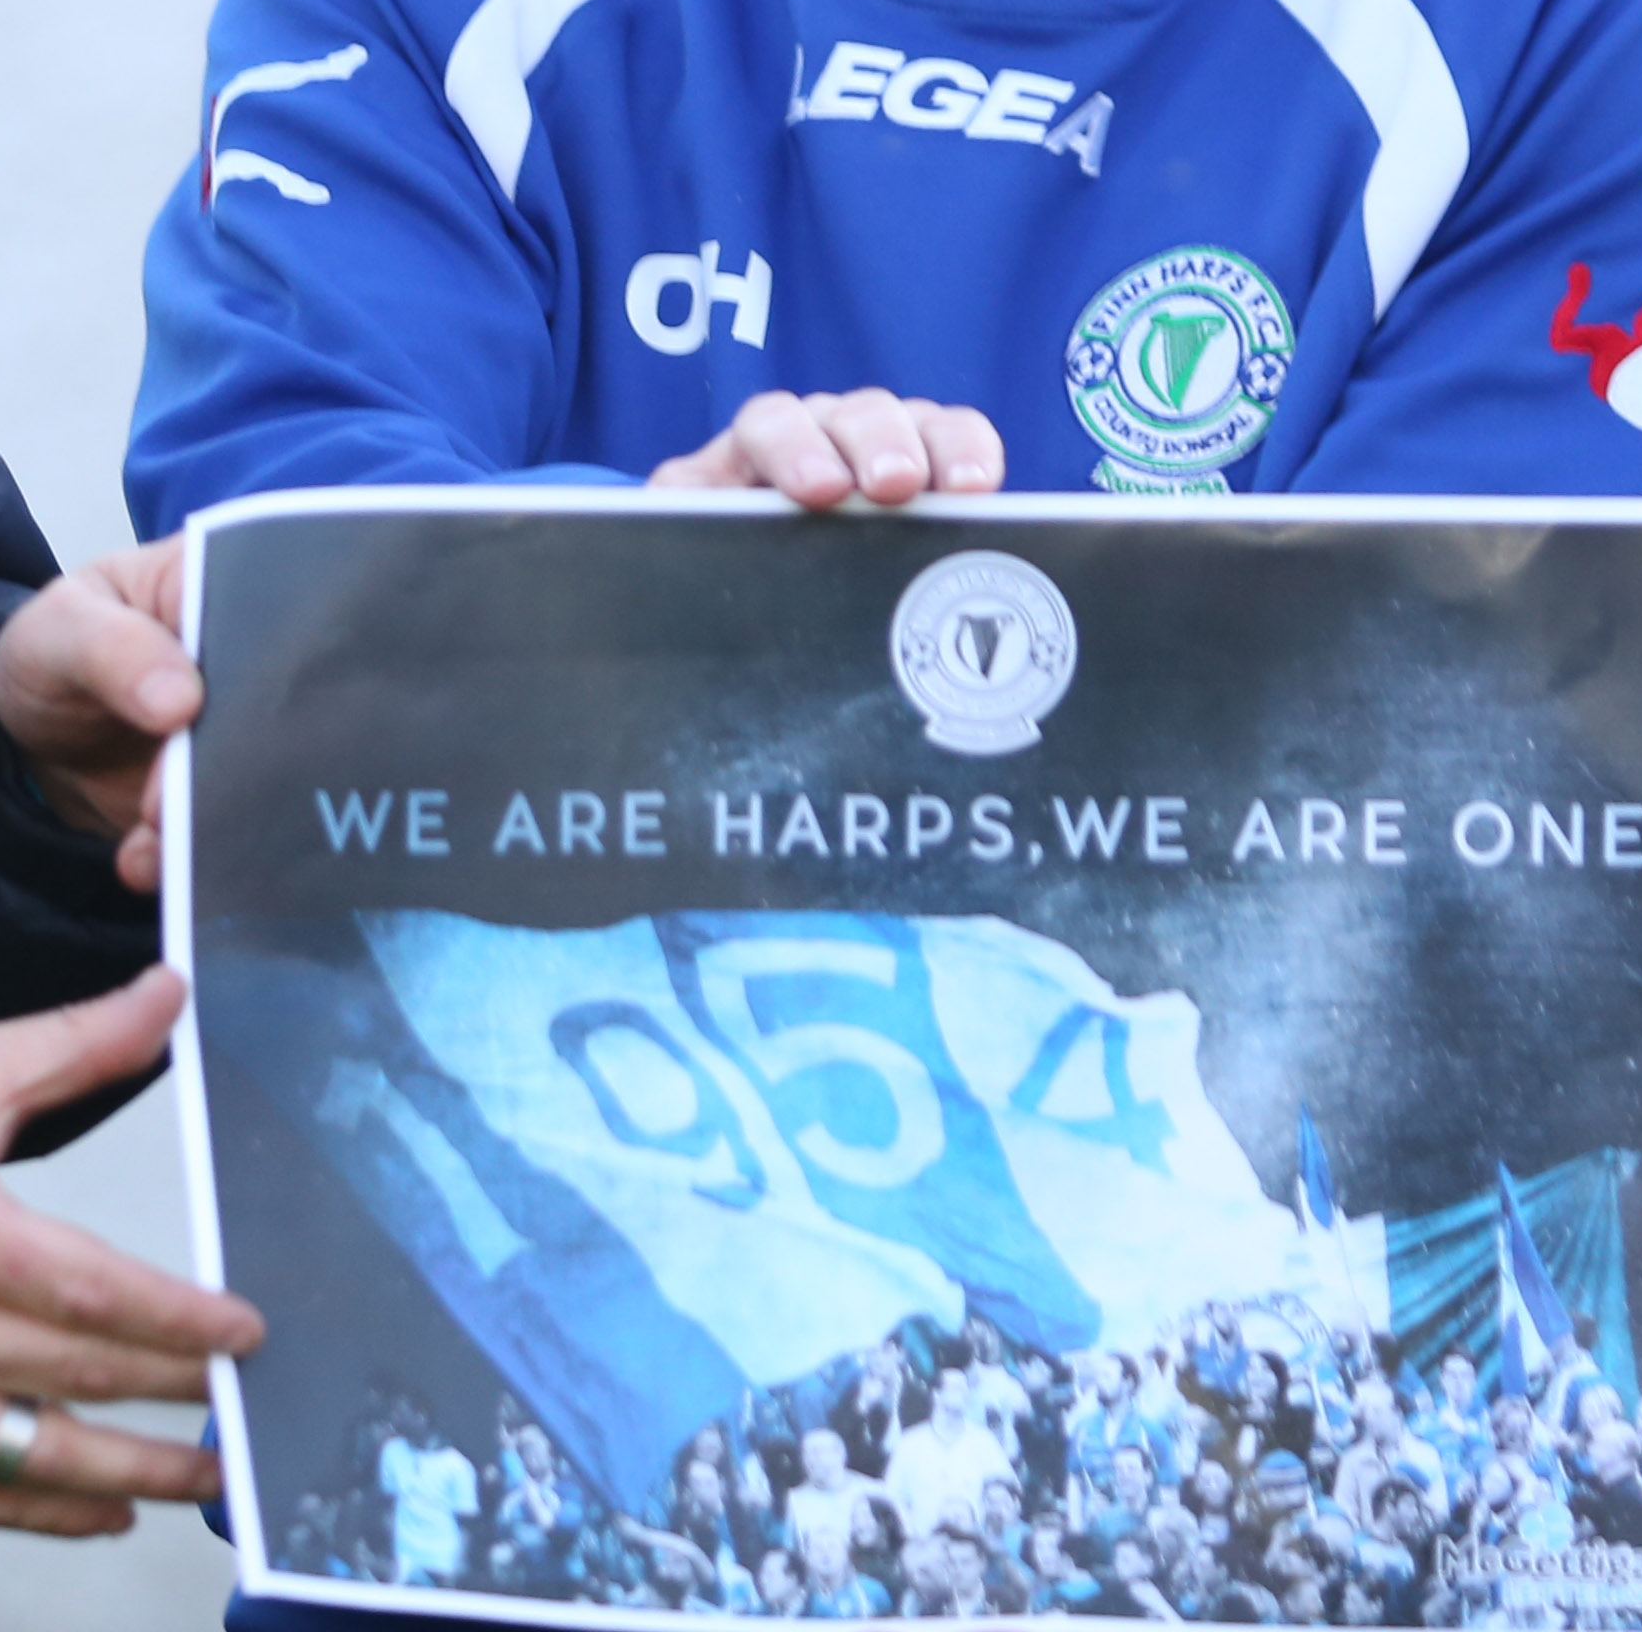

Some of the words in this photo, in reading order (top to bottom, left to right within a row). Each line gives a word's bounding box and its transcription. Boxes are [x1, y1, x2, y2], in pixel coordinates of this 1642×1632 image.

[314, 789, 451, 855] WE
[491, 790, 667, 856] ARE
[1231, 796, 1408, 866] ARE
